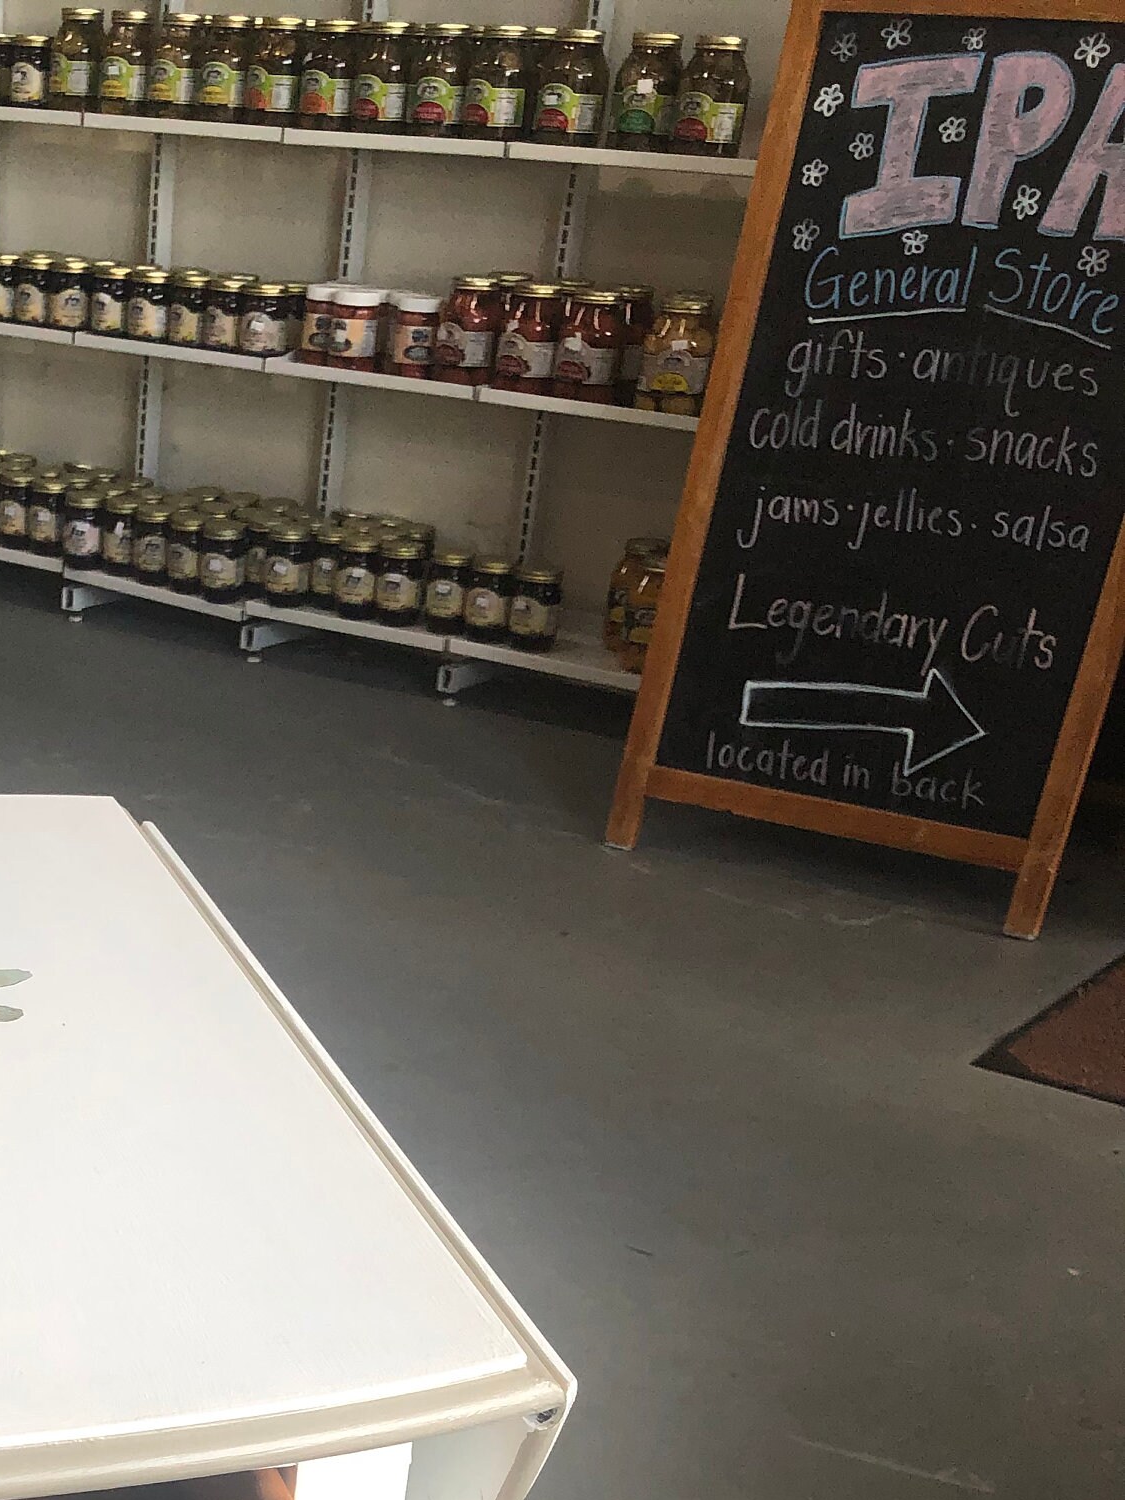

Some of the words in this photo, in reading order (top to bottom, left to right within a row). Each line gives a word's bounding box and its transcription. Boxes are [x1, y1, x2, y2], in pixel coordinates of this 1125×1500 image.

[805, 246, 978, 310] General
[988, 248, 1118, 334] Store
[784, 329, 887, 397] gifts
[912, 338, 1099, 417] antiques
[749, 400, 822, 450] cold
[830, 402, 938, 462] drinks
[963, 425, 1098, 477] snacks
[736, 486, 840, 549] jams
[846, 487, 963, 550] jellies
[990, 505, 1091, 552] salsa
[727, 573, 949, 677] Legendary
[961, 605, 1057, 669] Cuts
[705, 730, 830, 786] located
[842, 755, 871, 790] in
[890, 762, 984, 808] back
